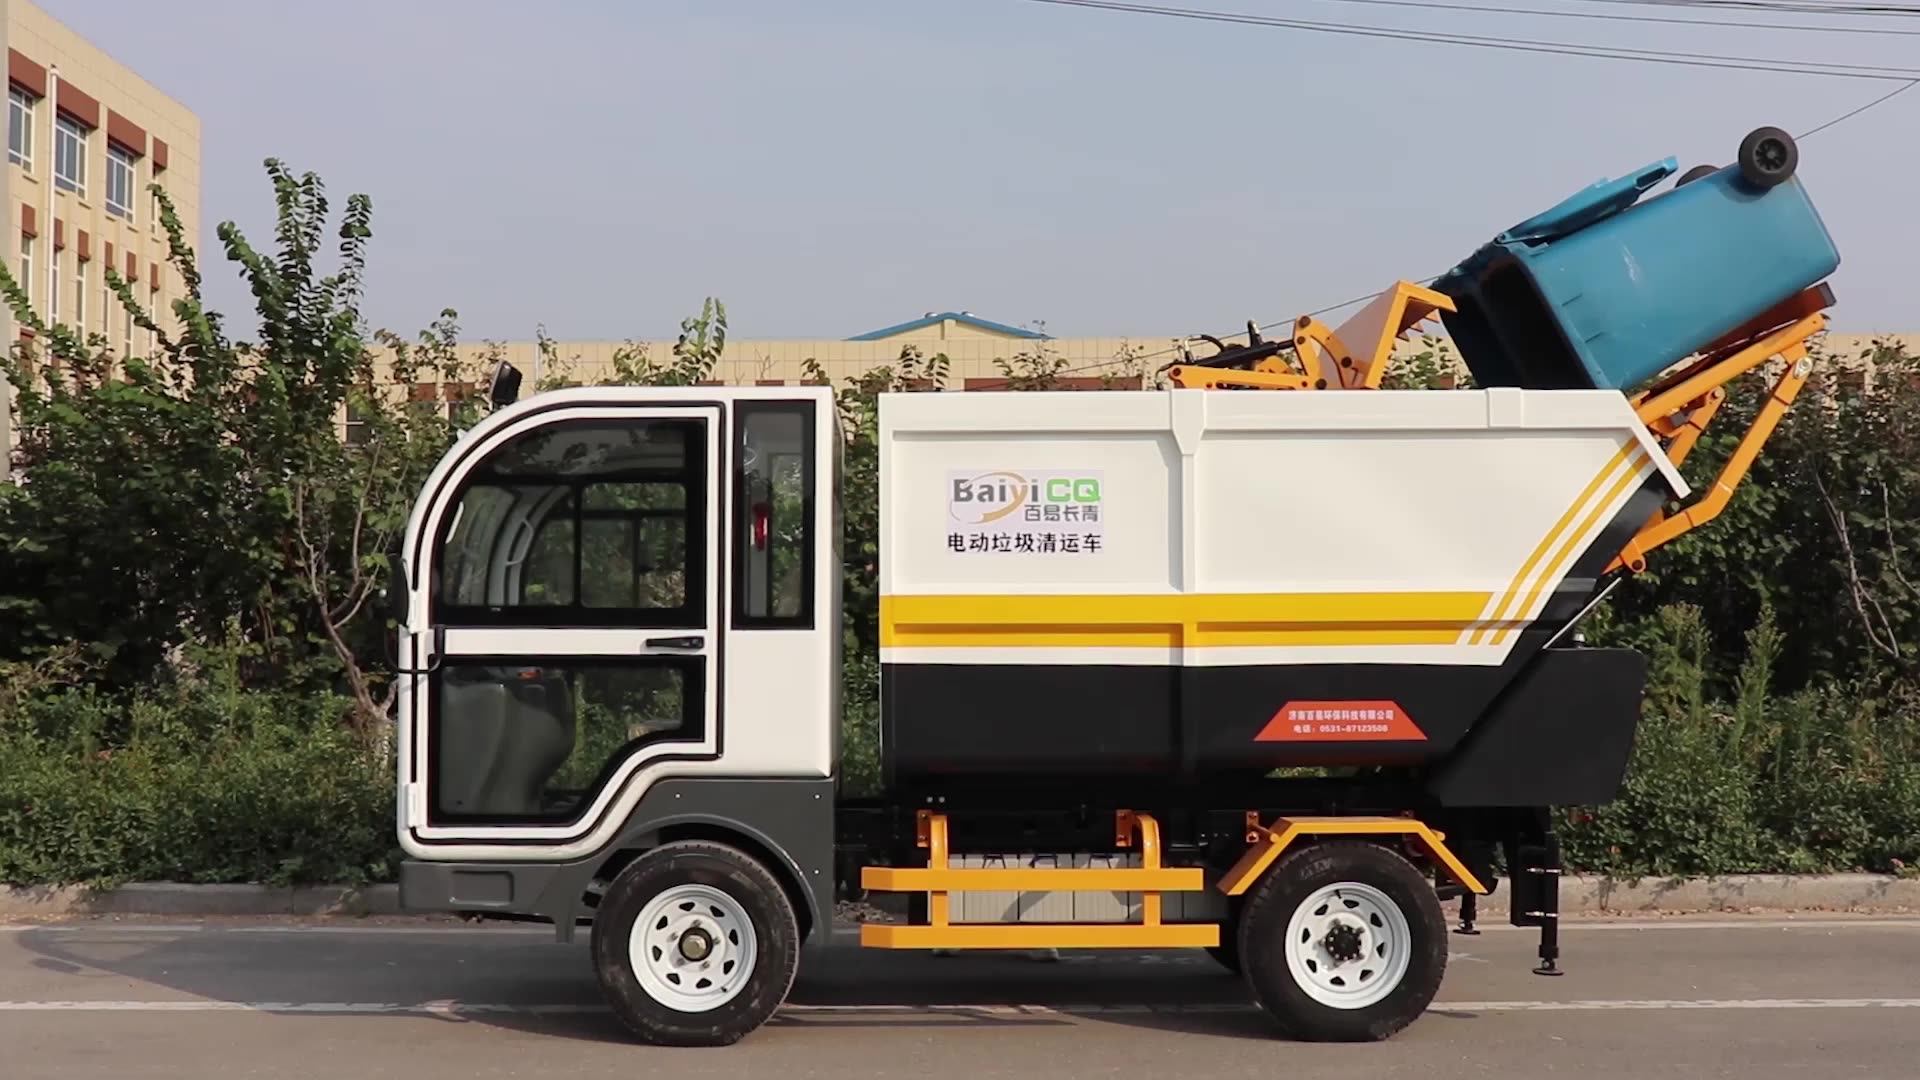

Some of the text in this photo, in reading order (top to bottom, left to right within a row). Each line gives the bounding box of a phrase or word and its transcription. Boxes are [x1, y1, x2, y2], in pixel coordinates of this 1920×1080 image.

[1024, 504, 1098, 522] 百易长青
[948, 532, 1102, 553] 电动垃圾清运车
